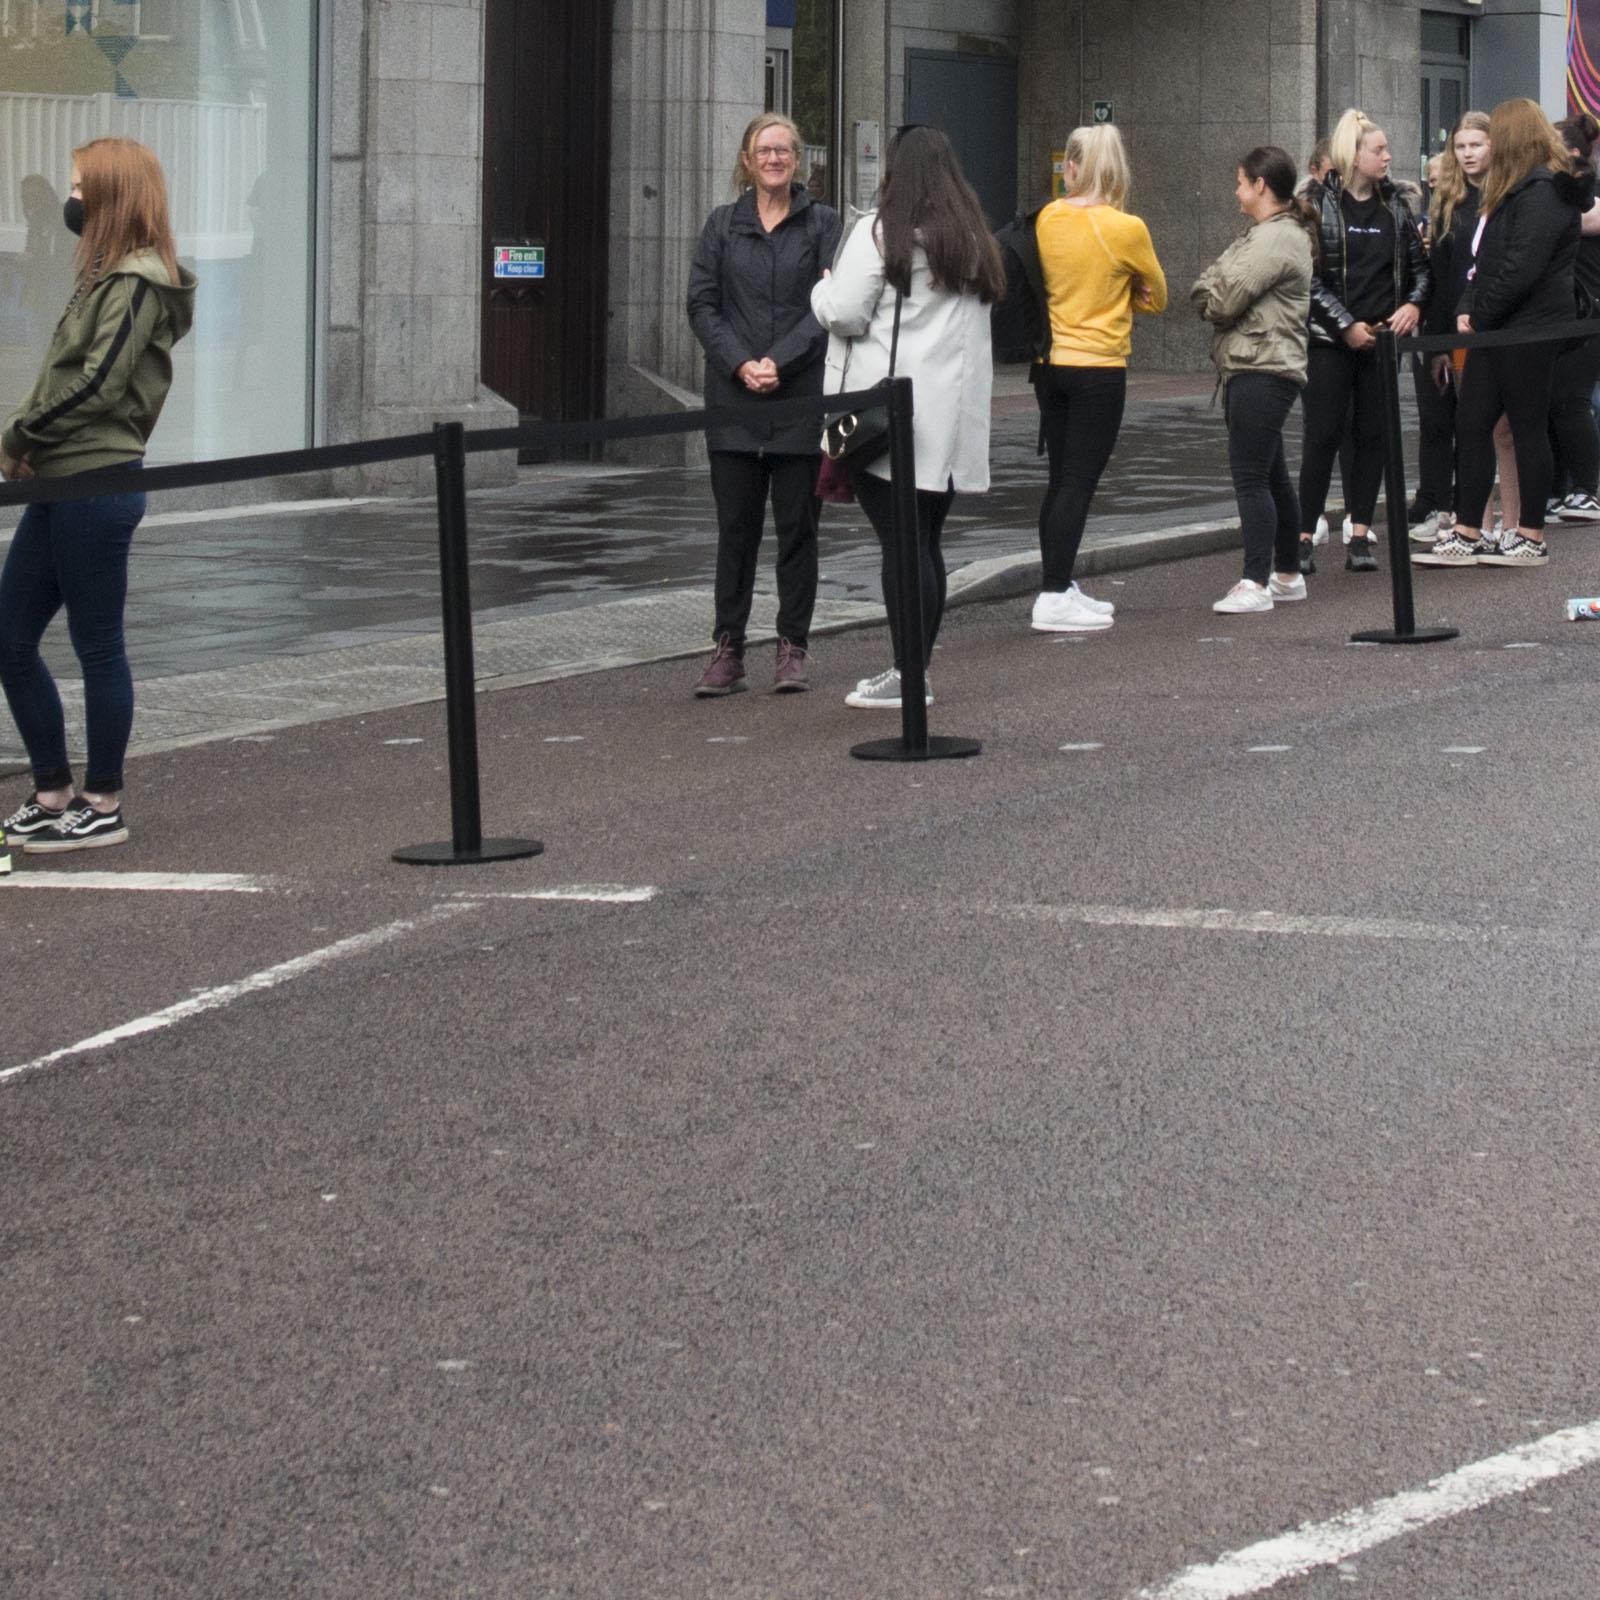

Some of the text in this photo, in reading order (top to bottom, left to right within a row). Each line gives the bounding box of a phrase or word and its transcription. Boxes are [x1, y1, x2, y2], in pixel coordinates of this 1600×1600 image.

[509, 250, 537, 261] Fire exit
[507, 263, 522, 274] Keep
